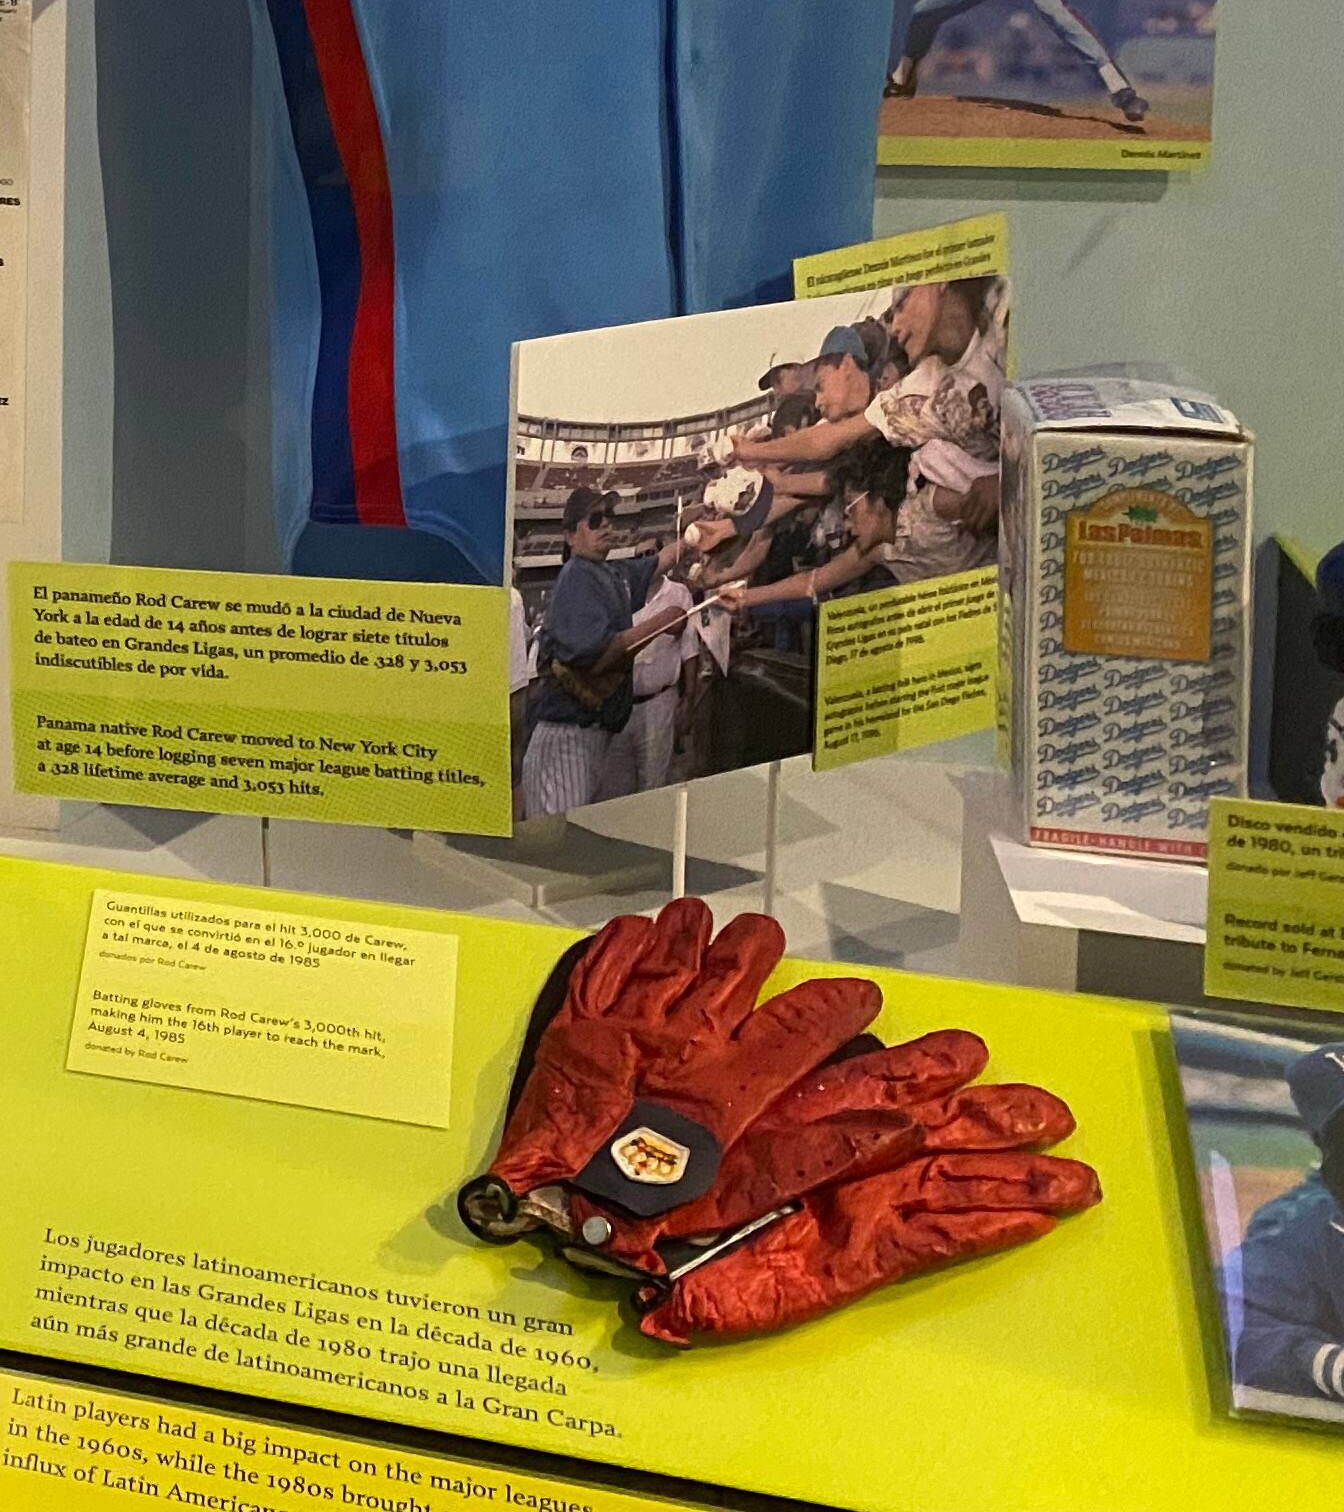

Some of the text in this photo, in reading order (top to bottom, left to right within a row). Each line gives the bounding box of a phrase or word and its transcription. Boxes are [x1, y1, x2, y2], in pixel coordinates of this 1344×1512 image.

[32, 584, 462, 626] El panameño Rod Carew se mudó a la ciudad de Nueva
[35, 714, 438, 762] Panama native Rod Carew moved to New York City
[1226, 835, 1295, 856] de 1980,
[1227, 814, 1337, 838] Disco vendido
[1224, 913, 1315, 935] Record sold
[86, 1020, 185, 1044] August 4, 1985
[91, 988, 139, 1008] Batting
[140, 997, 182, 1012] gloves
[185, 1002, 216, 1017] from
[219, 1006, 246, 1022] Rod
[303, 1018, 360, 1038] 3,000th
[43, 1227, 573, 1336] Los jugadores latinoamericanos tuvieron un gran
[11, 1387, 66, 1414] Latin
[73, 1400, 150, 1430] players
[156, 1414, 196, 1439] had
[202, 1429, 215, 1444] a
[221, 1426, 257, 1456] big
[261, 1435, 340, 1469] impact
[347, 1458, 377, 1476] on
[383, 1461, 422, 1485] the
[429, 1474, 498, 1500] major
